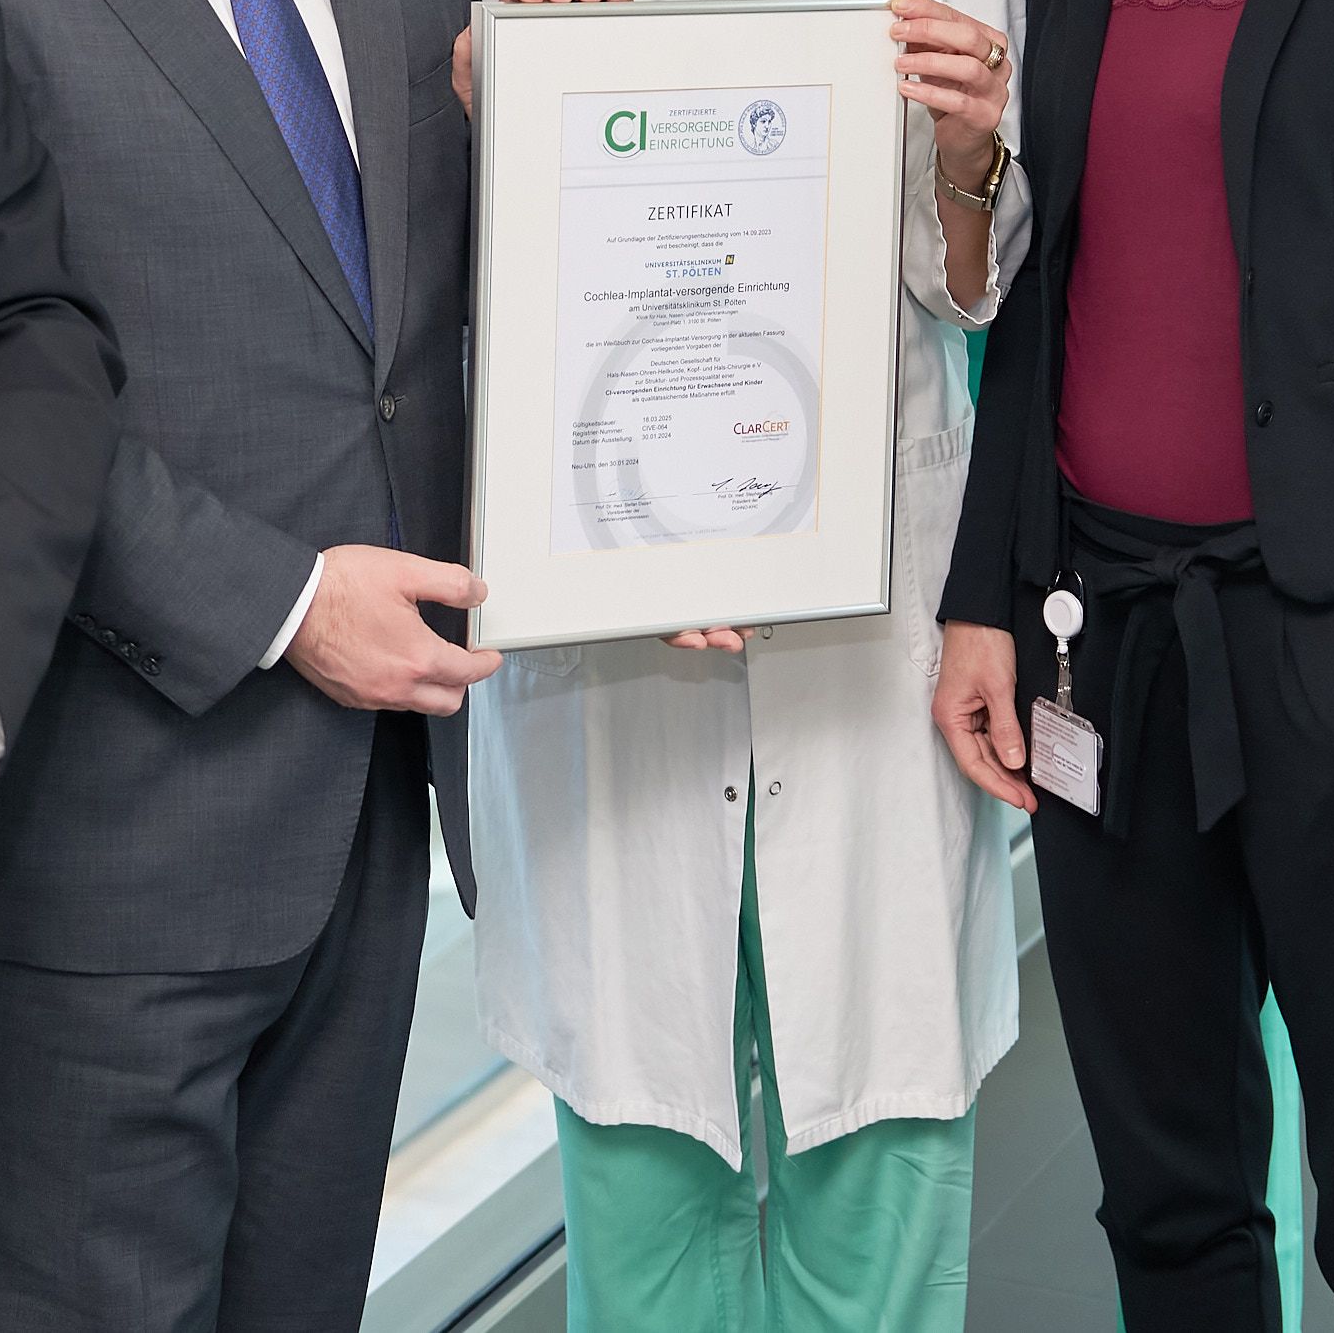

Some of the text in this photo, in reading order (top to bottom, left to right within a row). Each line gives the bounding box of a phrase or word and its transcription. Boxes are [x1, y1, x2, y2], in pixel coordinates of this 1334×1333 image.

[669, 108, 717, 117] ZERTIFIZIERTE
[604, 110, 647, 152] CI
[650, 120, 734, 134] VERSORGENDE
[649, 137, 734, 151] EINRICHTUNG
[648, 203, 733, 221] ZERTIFIKAT
[617, 234, 646, 243] Grundlage
[644, 258, 722, 268] UNIVERSITÄTSKLINIKUM
[665, 266, 722, 278] ST. PÖLTEN
[584, 281, 790, 301] Cochlea-Implantat-versorgende Einrichtung
[641, 300, 711, 311] Universitätsklinikum
[724, 298, 747, 306] Pölten
[738, 330, 762, 338] aktuellen
[763, 329, 785, 338] Fassung
[650, 343, 685, 352] vorliegenden
[686, 342, 712, 351] Vorgaben
[650, 359, 679, 367] Deutschen
[680, 357, 712, 365] Gesellschaft
[680, 373, 720, 382] Prozessqualität
[605, 387, 653, 396] CI-versorgenden
[653, 384, 687, 393] Einrichtung
[697, 381, 731, 389] Erwachsene
